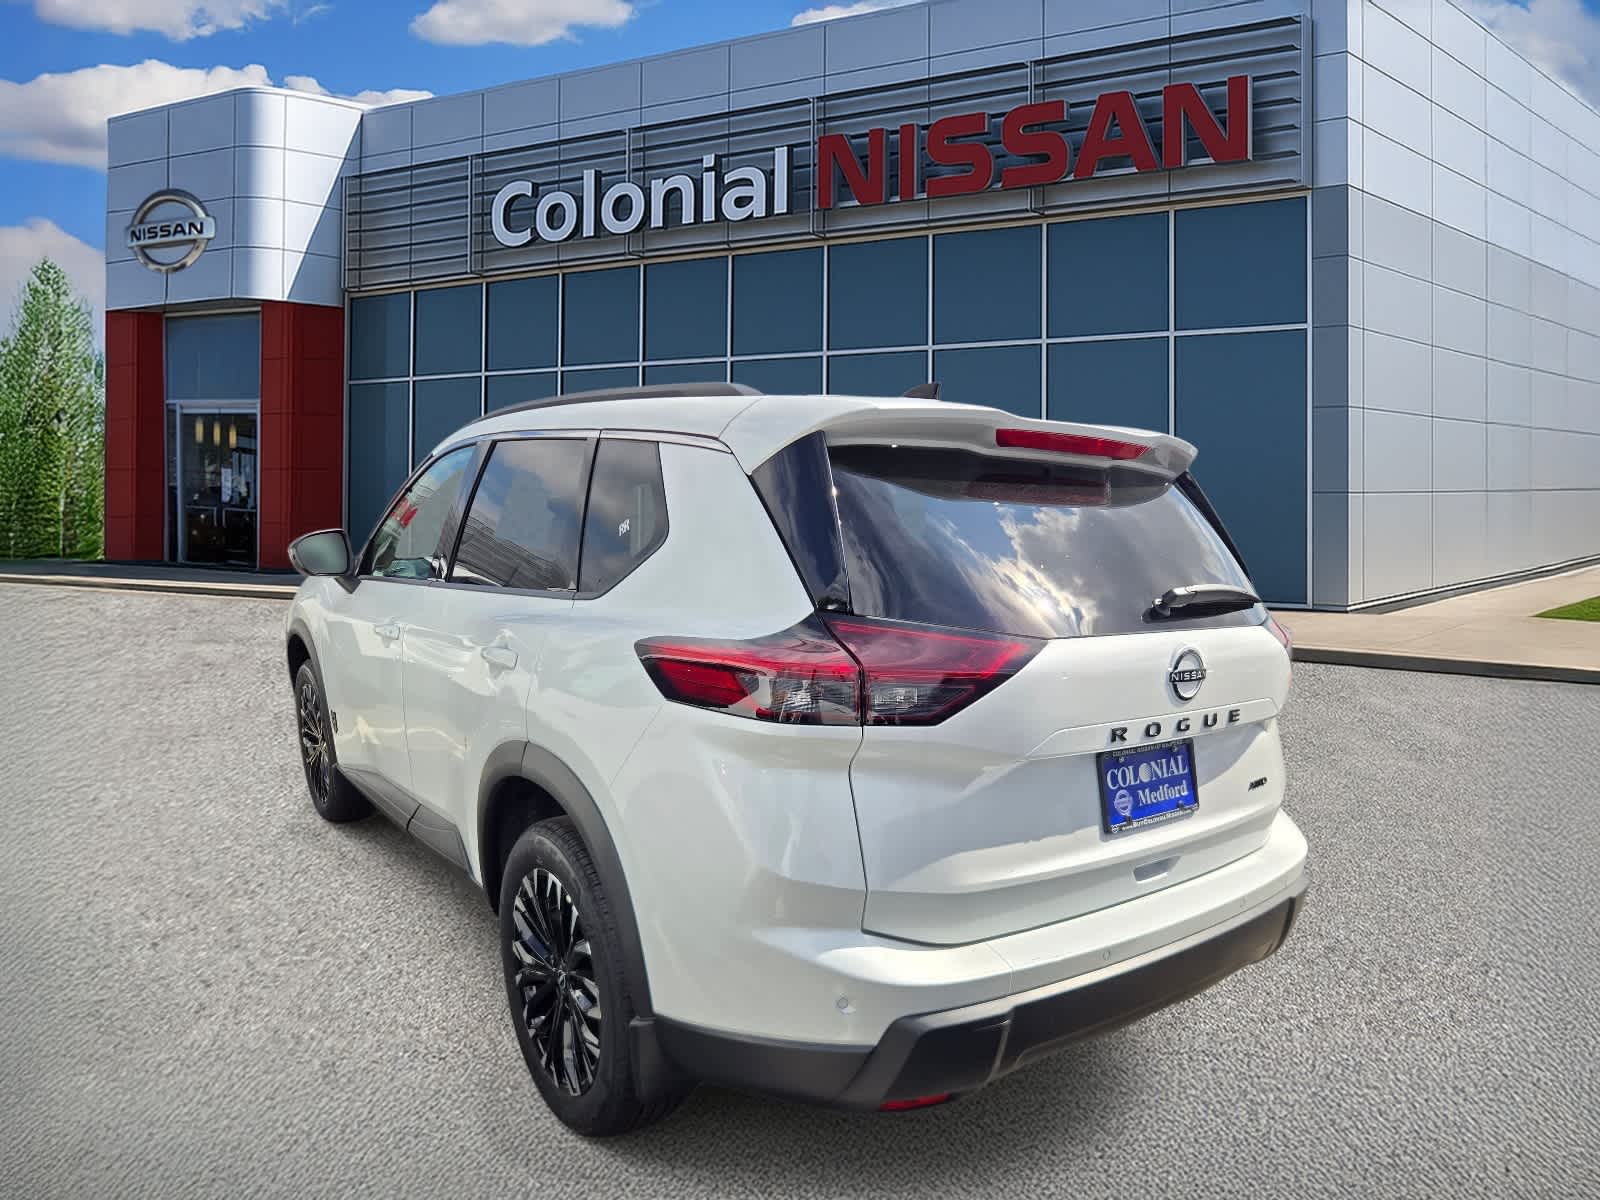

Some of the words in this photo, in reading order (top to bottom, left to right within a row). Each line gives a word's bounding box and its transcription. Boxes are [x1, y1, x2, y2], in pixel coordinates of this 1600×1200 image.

[491, 146, 788, 248] Colonial
[818, 75, 1252, 209] NISSAN
[130, 221, 204, 242] NISSAN
[1110, 709, 1241, 742] ROGUE
[1107, 755, 1188, 790] COLONIAL
[1137, 779, 1188, 806] Medford
